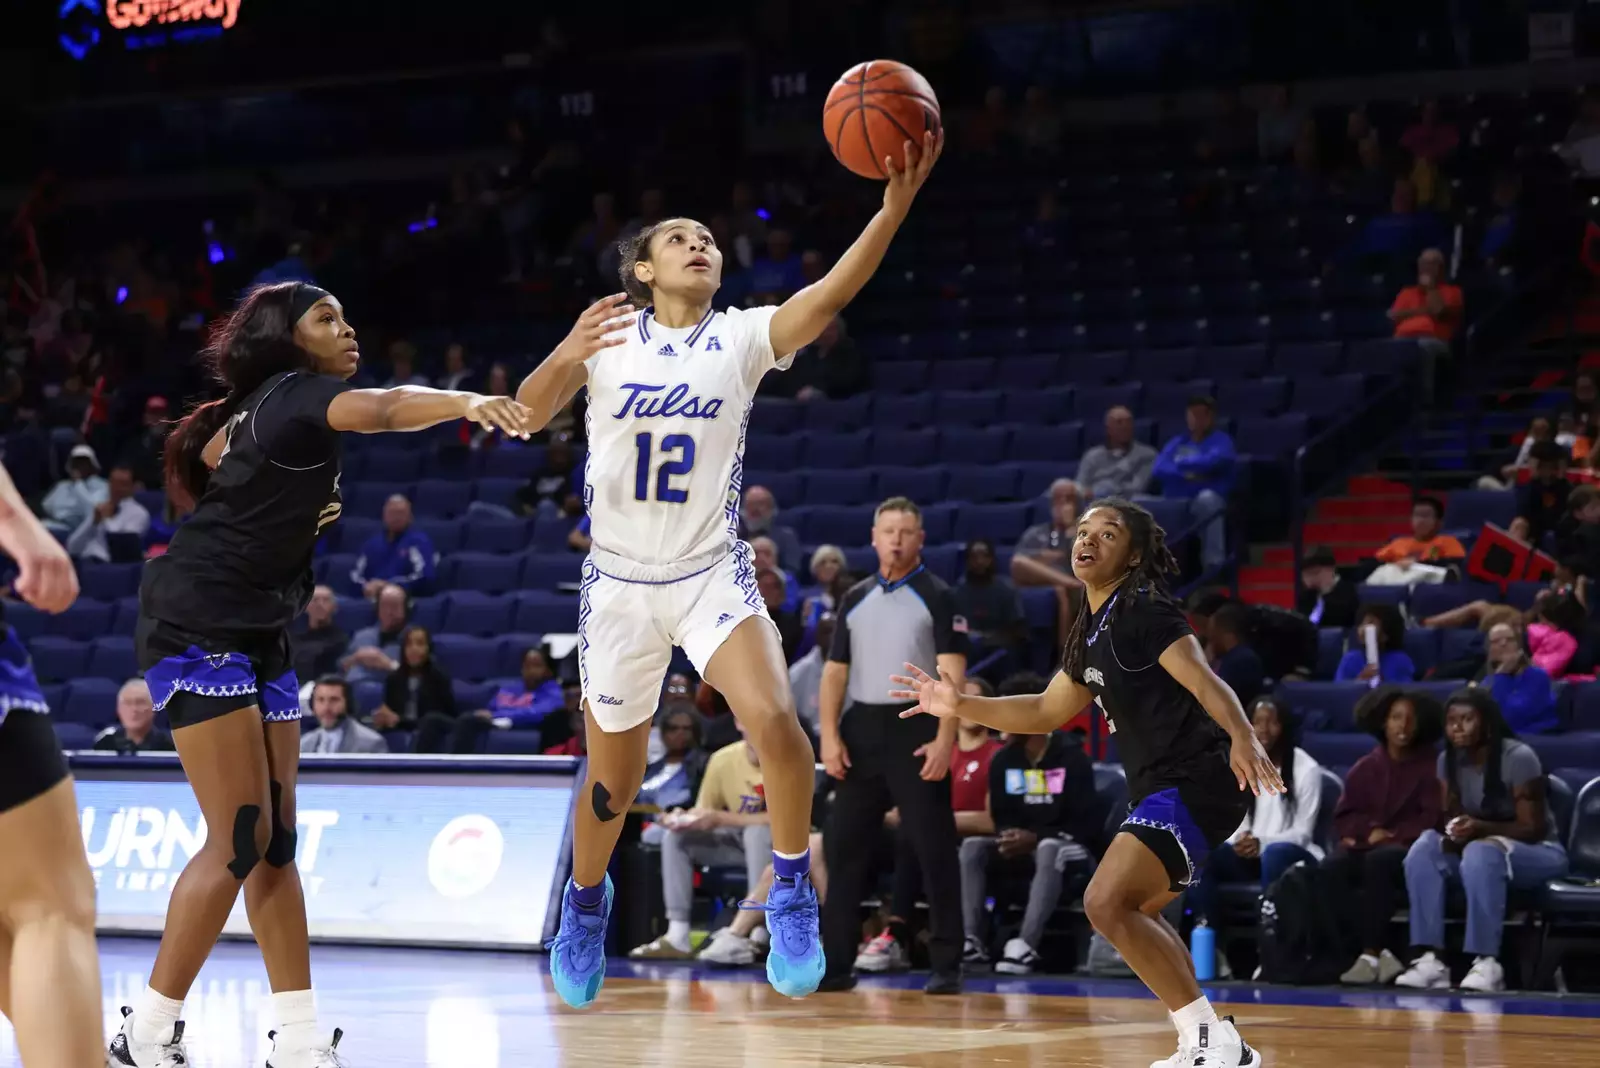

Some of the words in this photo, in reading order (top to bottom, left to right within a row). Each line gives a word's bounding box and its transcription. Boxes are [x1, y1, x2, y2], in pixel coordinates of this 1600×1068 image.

[611, 383, 724, 420] Tulsa
[634, 432, 696, 504] 12
[597, 694, 625, 706] Tulsa
